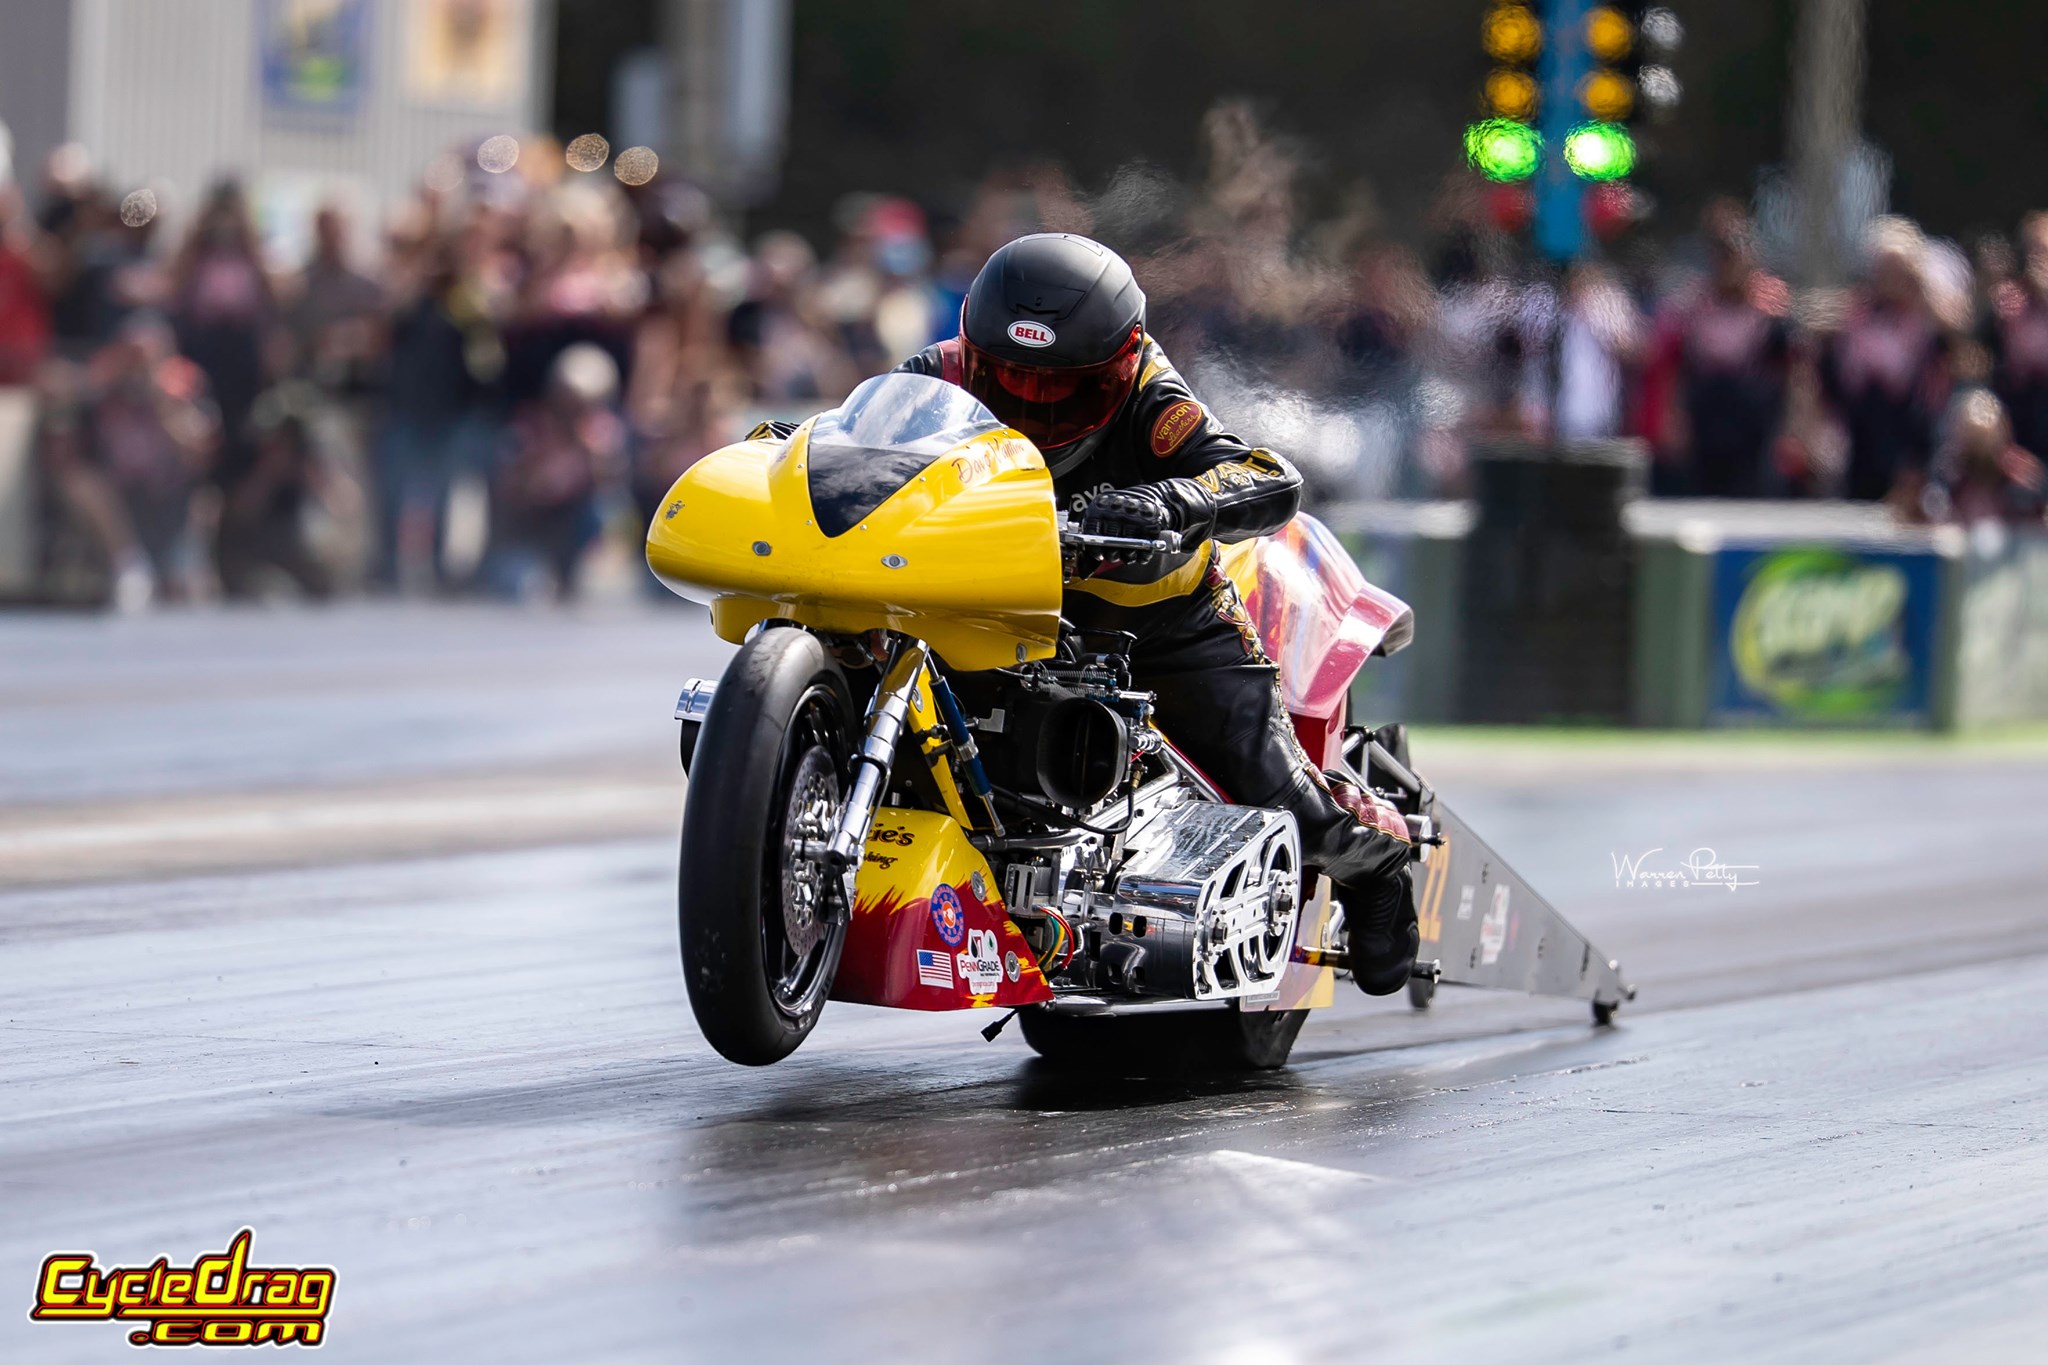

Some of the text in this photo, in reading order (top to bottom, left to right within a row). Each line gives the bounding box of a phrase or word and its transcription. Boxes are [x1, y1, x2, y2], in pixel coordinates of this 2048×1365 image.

[1015, 327, 1048, 342] BELL
[1156, 404, 1191, 441] vanson
[1071, 482, 1115, 512] ave
[867, 822, 915, 847] ie's
[863, 851, 898, 870] king
